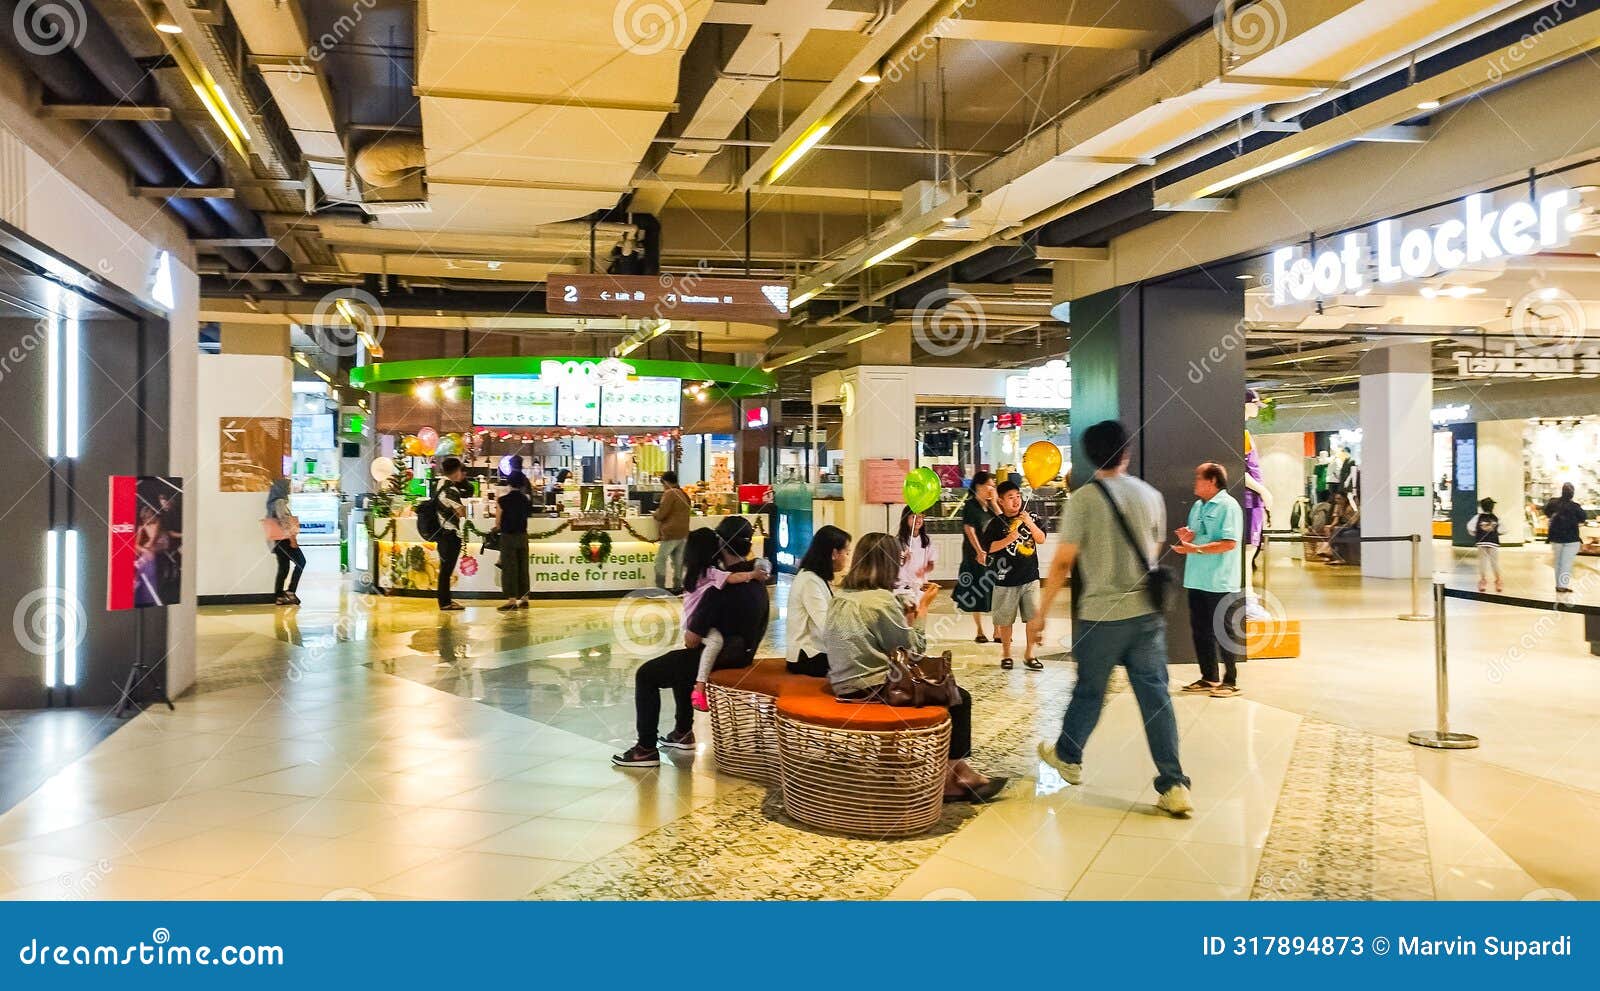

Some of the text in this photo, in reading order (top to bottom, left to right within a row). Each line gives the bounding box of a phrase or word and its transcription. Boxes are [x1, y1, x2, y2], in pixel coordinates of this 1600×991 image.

[1273, 233, 1365, 305] Foot
[563, 285, 577, 302] 2
[536, 567, 646, 581] made for real.
